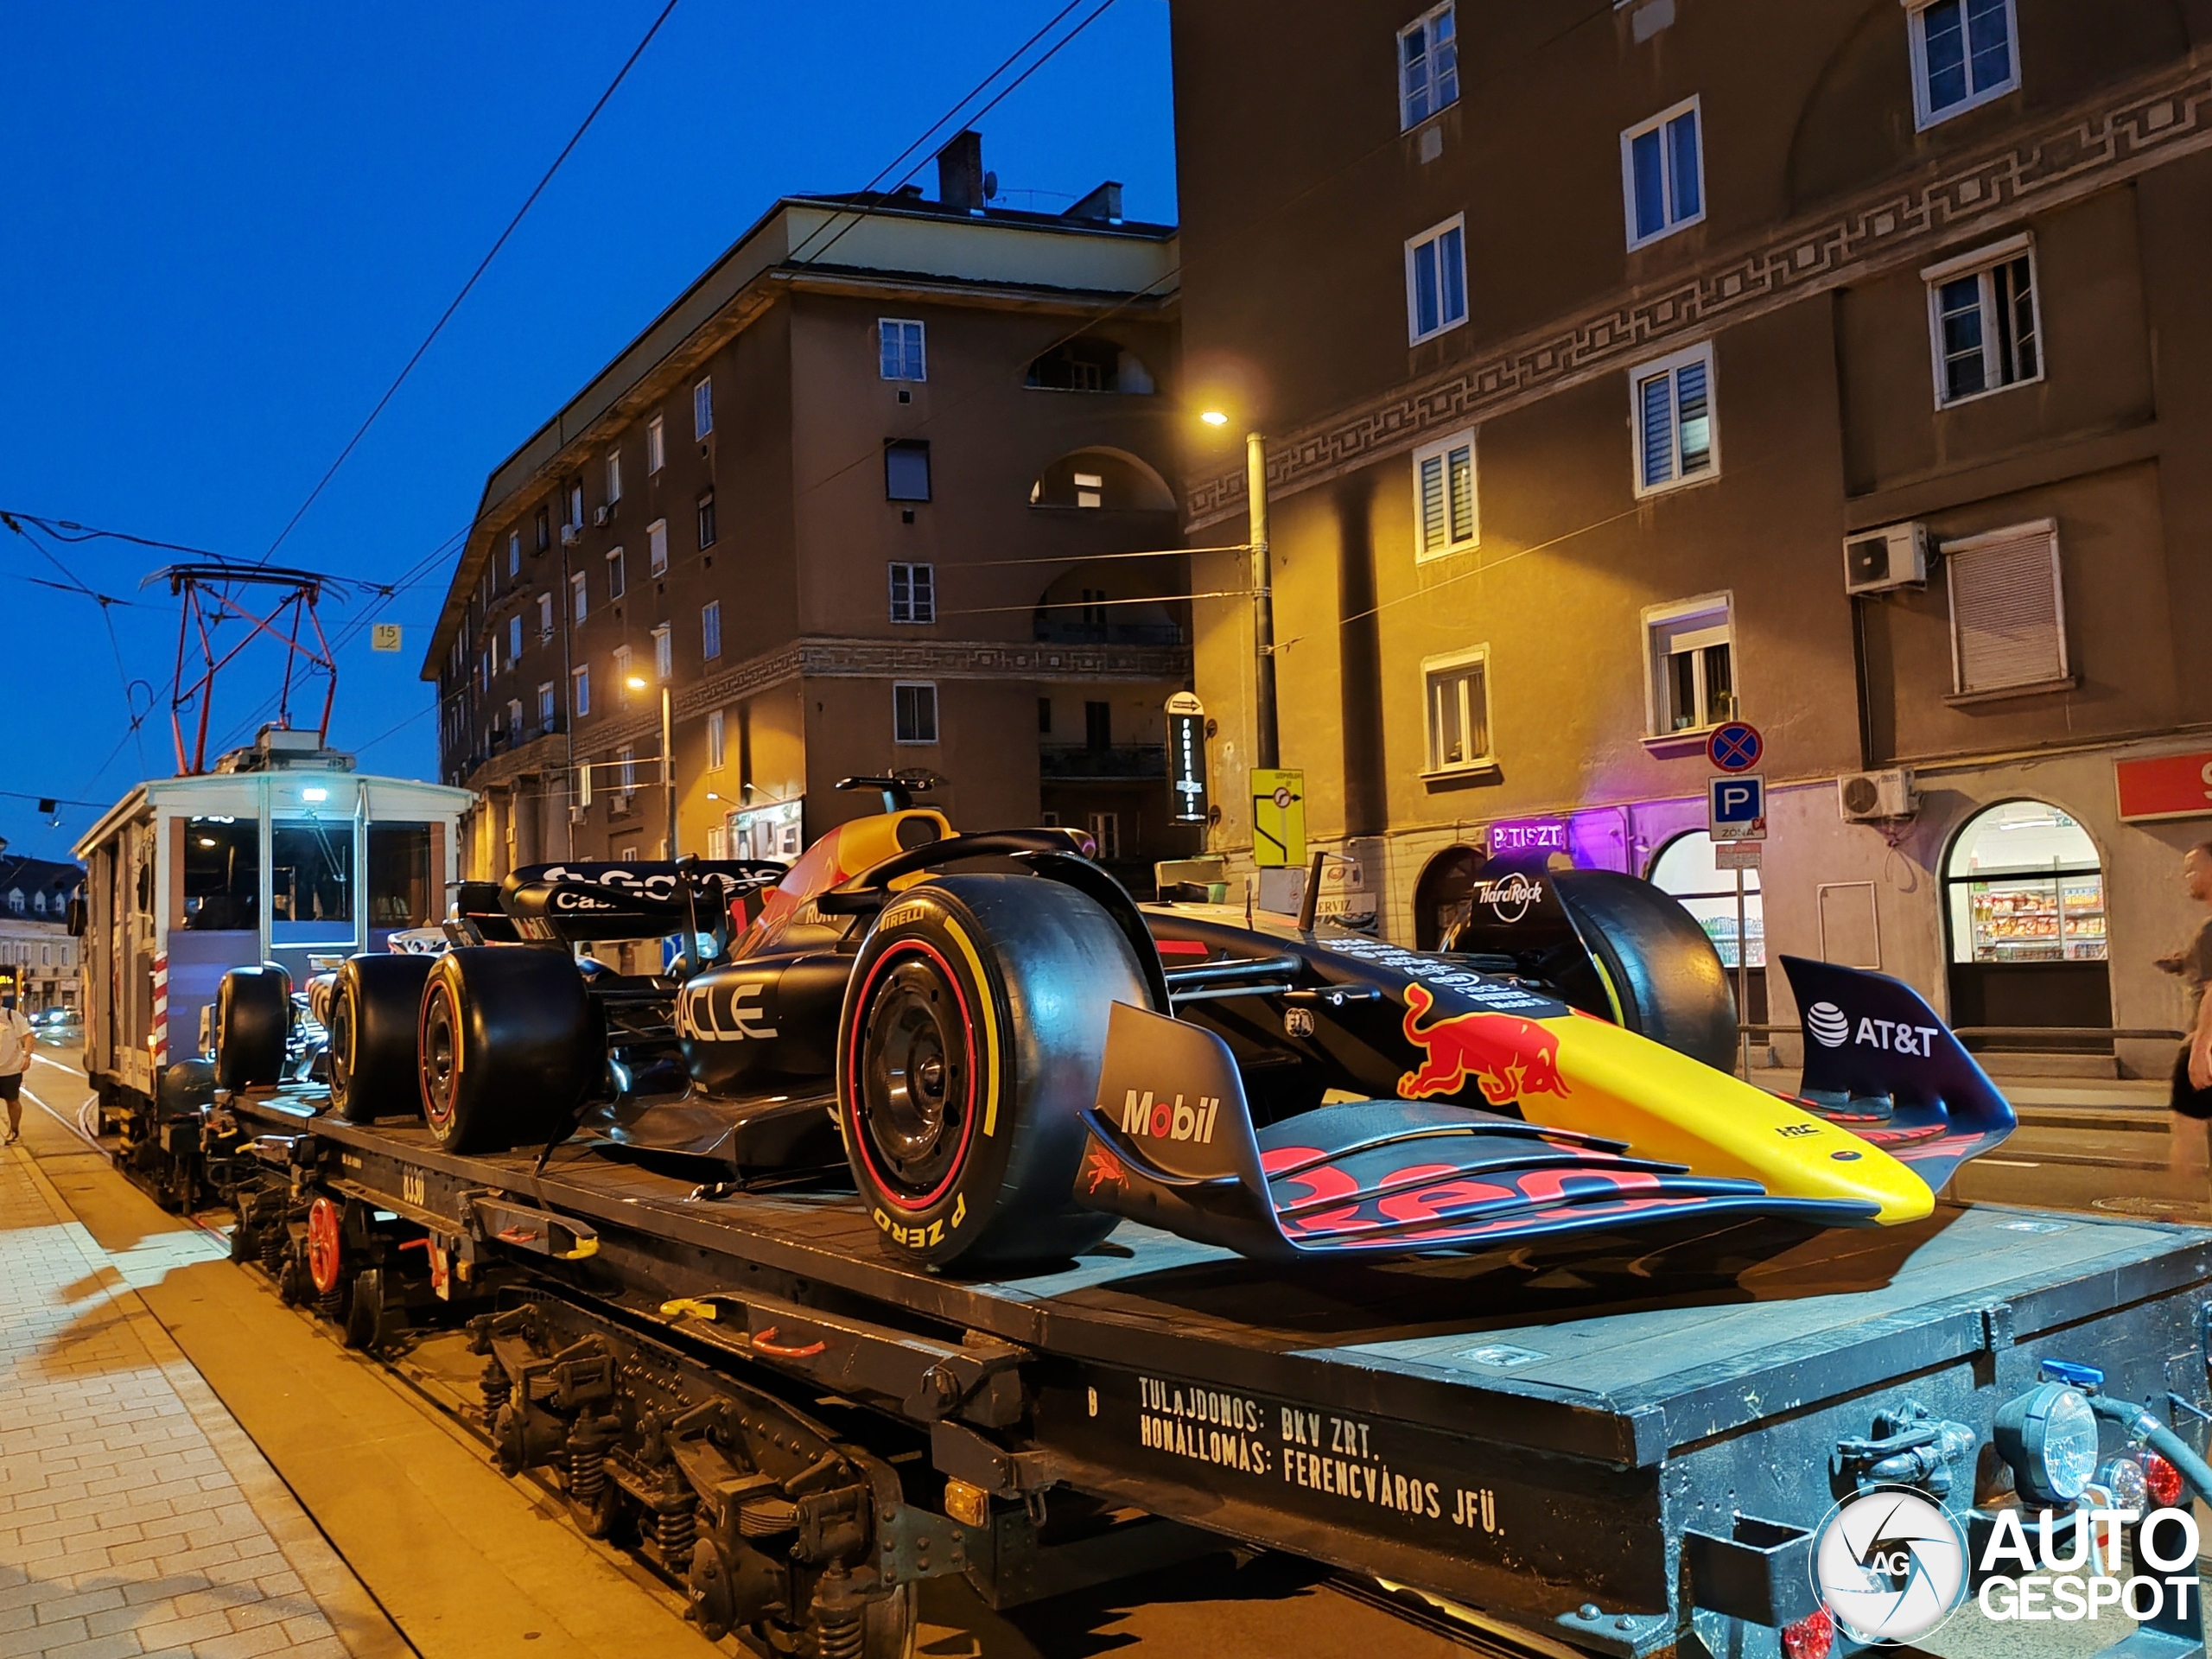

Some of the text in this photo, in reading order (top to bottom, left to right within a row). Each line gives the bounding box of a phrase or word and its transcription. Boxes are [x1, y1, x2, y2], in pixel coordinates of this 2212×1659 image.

[379, 626, 395, 638] 15
[1724, 788, 1750, 816] P
[880, 899, 925, 931] PIRELLI
[1316, 899, 1352, 913] ERVIZ
[1855, 1017, 1938, 1058] AT&T
[1122, 1090, 1219, 1144] Mobil
[874, 1207, 944, 1248] ZERO
[1139, 1376, 1380, 1460] TULAJDONOS: BKV ZRT.
[1141, 1414, 1505, 1536] HONÁLLOMÁS: FERENCVÁROS JFÜ.
